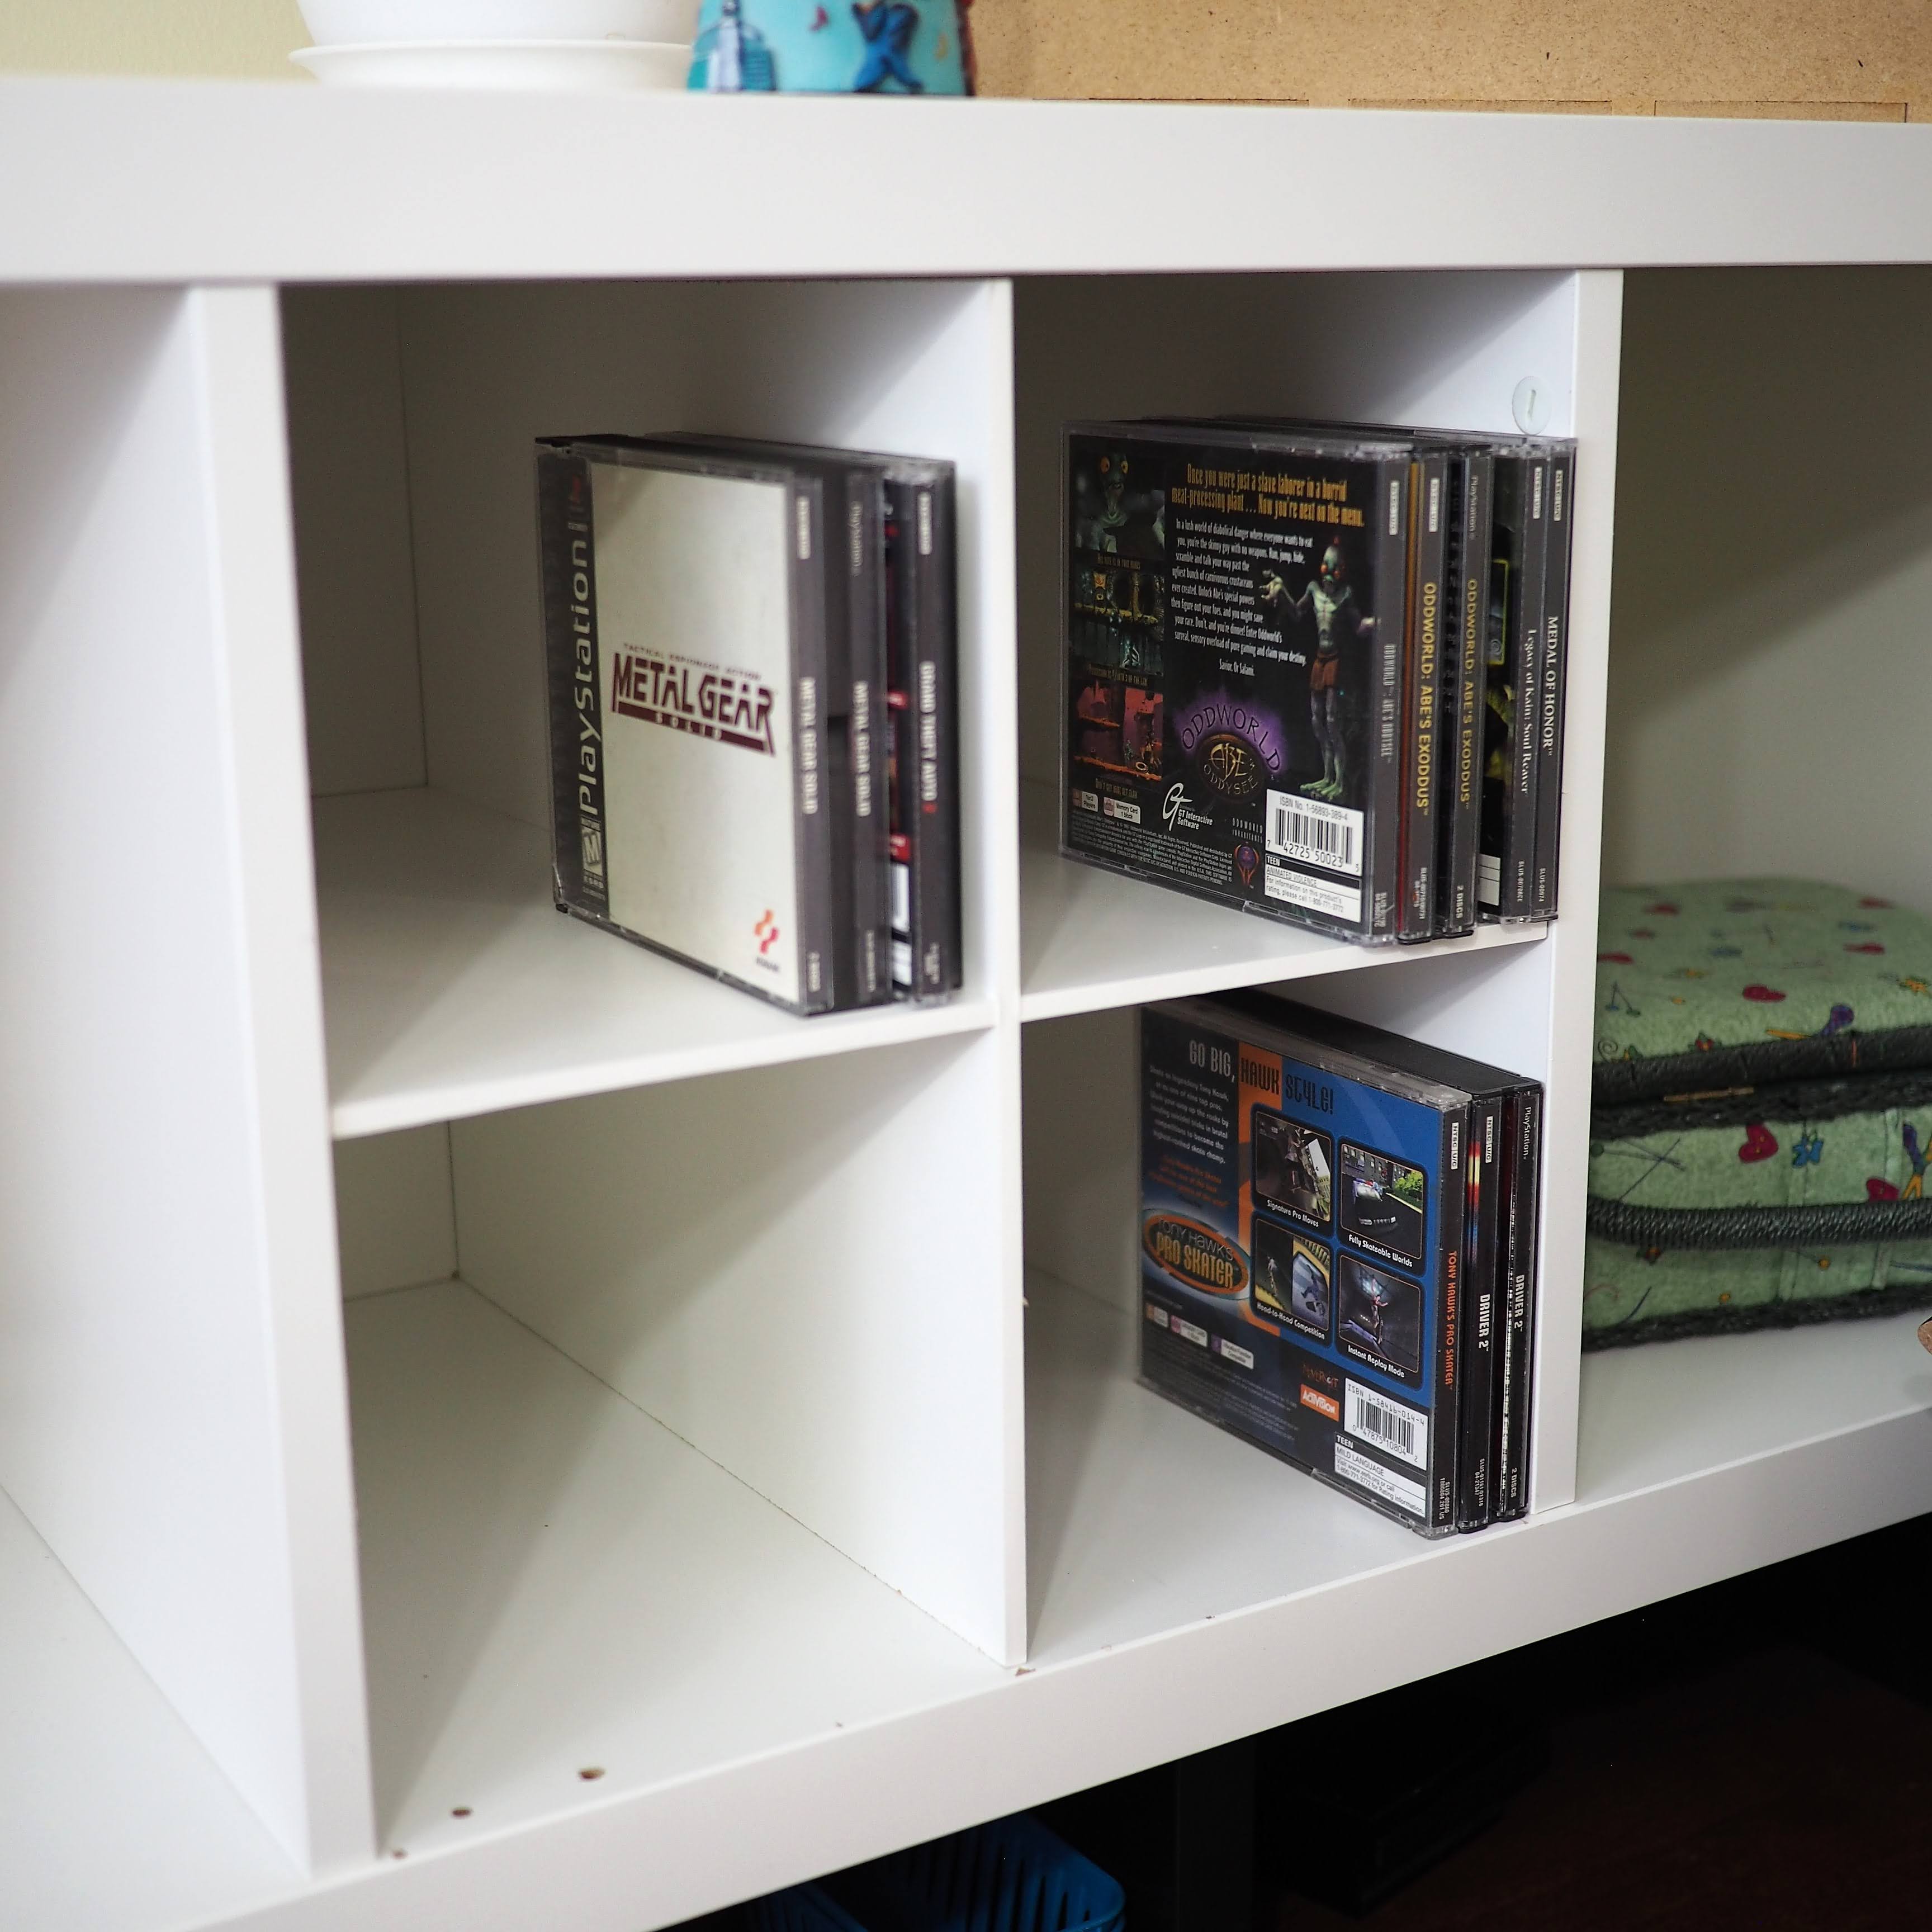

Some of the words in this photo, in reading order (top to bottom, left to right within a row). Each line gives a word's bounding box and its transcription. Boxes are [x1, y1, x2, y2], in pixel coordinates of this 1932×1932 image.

[1187, 463, 1202, 485] Once
[1205, 469, 1216, 489] you
[1218, 471, 1235, 488] were
[1237, 470, 1249, 492] just
[1252, 475, 1256, 491] a
[1258, 471, 1276, 494] slave
[1278, 473, 1305, 496] laborer
[1306, 477, 1314, 498] in
[1315, 481, 1320, 499] a
[1322, 477, 1347, 502] horrid
[1172, 487, 1225, 513] meal-processing
[1227, 490, 1243, 513] plant
[1258, 493, 1272, 515] Now
[1274, 496, 1298, 519] you're
[1299, 503, 1314, 521] next
[1317, 504, 1325, 522] on
[1327, 502, 1339, 524] the
[1469, 476, 1479, 532] PlayStation
[1213, 558, 1221, 569] your
[1421, 581, 1437, 679] ODDWORLD:
[1465, 579, 1478, 675] ODDWORLD:
[1546, 616, 1559, 667] MEDAL
[623, 643, 664, 659] TACTICAL
[1523, 629, 1537, 669] Legacy
[571, 540, 602, 816] PlayStation
[919, 660, 936, 713] GRAND
[1526, 672, 1534, 684] of
[1546, 670, 1556, 690] OF
[612, 652, 695, 713] METAL
[699, 674, 776, 757] GEAR
[799, 676, 816, 726] METAL
[853, 680, 869, 729] METAL
[1382, 699, 1394, 721] ABE'S
[1419, 684, 1433, 728] ABE'S
[1463, 680, 1474, 723] ABE'S
[1524, 688, 1535, 720] Kain:
[656, 711, 722, 740] SOLID
[920, 713, 937, 760] THEFT
[1182, 704, 1280, 770] ODDWORLD
[1523, 723, 1533, 749] Soul
[801, 728, 817, 770] GEAR
[855, 731, 870, 772] GEAR
[802, 771, 818, 815] SOLID
[922, 761, 938, 801] AUTO
[1204, 764, 1258, 795] ODDYSEE
[1521, 753, 1532, 796] Reaver
[856, 773, 871, 816] SOLID
[1116, 803, 1129, 812] Memory
[1280, 795, 1294, 808] ISBN
[1295, 801, 1303, 810] No.
[1177, 817, 1200, 830] Software
[1178, 809, 1185, 818] GT
[1186, 811, 1213, 825] Interactive
[1232, 818, 1263, 834] ODDWORLD
[1267, 840, 1271, 849] 7
[1283, 842, 1310, 859] 42725
[1315, 850, 1343, 868] 50023
[1267, 856, 1280, 866] TEEN
[1267, 866, 1292, 880] ANIMATED
[1292, 873, 1317, 887] VIOLENCE
[1456, 893, 1464, 918] DISCS
[1190, 1040, 1205, 1068] GO
[1211, 1046, 1235, 1083] BIG,
[1240, 1058, 1279, 1095] HAWK
[1523, 1107, 1532, 1156] PlayStation
[1267, 1199, 1291, 1216] Signature
[1292, 1210, 1301, 1220] Pro
[1303, 1214, 1319, 1228] Moves
[1156, 1231, 1181, 1265] PRO
[1184, 1244, 1234, 1289] SKATER
[1348, 1234, 1362, 1248] Fully
[1362, 1240, 1391, 1259] Skateable
[1392, 1252, 1413, 1267] Worlds
[1447, 1251, 1457, 1279] TONY
[1446, 1282, 1456, 1321] HAWK'S
[1479, 1294, 1490, 1337] DRIVER
[1514, 1275, 1525, 1318] DRIVER
[1257, 1302, 1294, 1325] Head-to-Head
[1294, 1319, 1325, 1340] Competition
[1446, 1324, 1455, 1346] PRO
[1348, 1344, 1367, 1360] Instant
[1367, 1354, 1388, 1371] Replay
[1388, 1363, 1405, 1378] Mode
[1347, 1384, 1363, 1398] ISBN
[1368, 1394, 1424, 1427] 1-58416-014-4
[1337, 1434, 1353, 1448] TEEN
[1363, 1426, 1382, 1444] 47875
[1386, 1437, 1406, 1456] 10804
[1337, 1446, 1351, 1459] MILD
[1352, 1451, 1385, 1476] LANGUAGE
